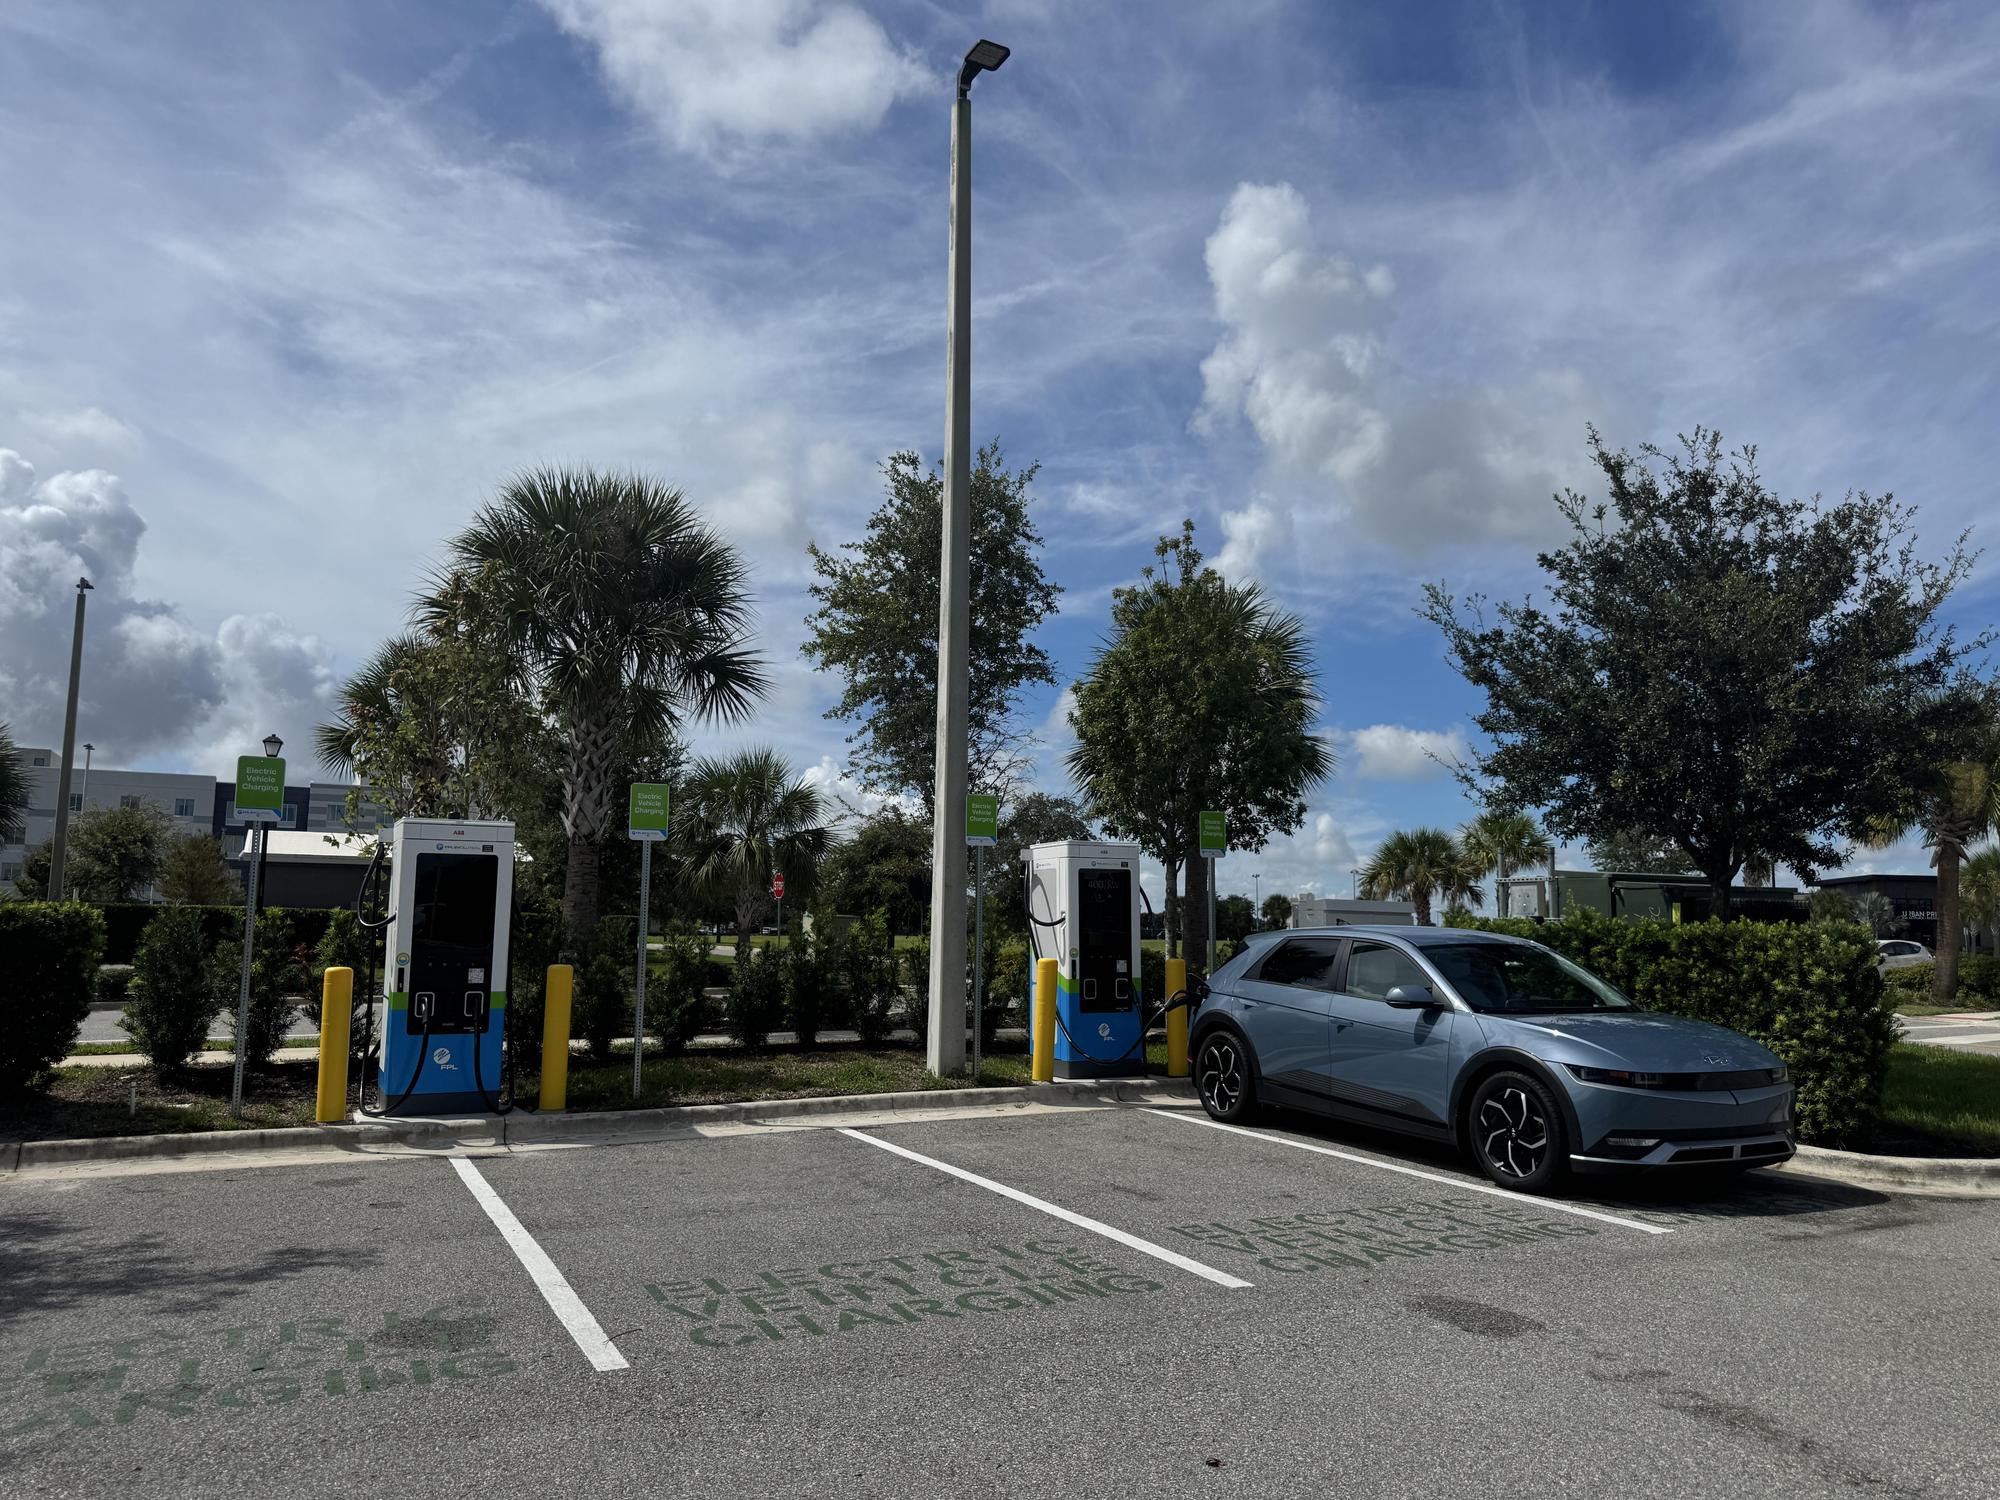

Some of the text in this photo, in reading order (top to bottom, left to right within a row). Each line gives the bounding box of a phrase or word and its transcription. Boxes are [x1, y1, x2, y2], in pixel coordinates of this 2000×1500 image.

[241, 783, 279, 792] Charging
[246, 767, 276, 775] Electric
[246, 775, 276, 783] Vehicle
[634, 807, 664, 815] Charging
[969, 815, 994, 823] Charging
[1168, 1199, 1493, 1241] ELECTRIC
[1199, 1208, 1542, 1255] VEHICLE
[1256, 1221, 1599, 1274] CHARGING
[642, 1239, 1079, 1303] ELECTRIC
[663, 1257, 1116, 1321] VEHICLE
[688, 1275, 1163, 1348] CHARGING
